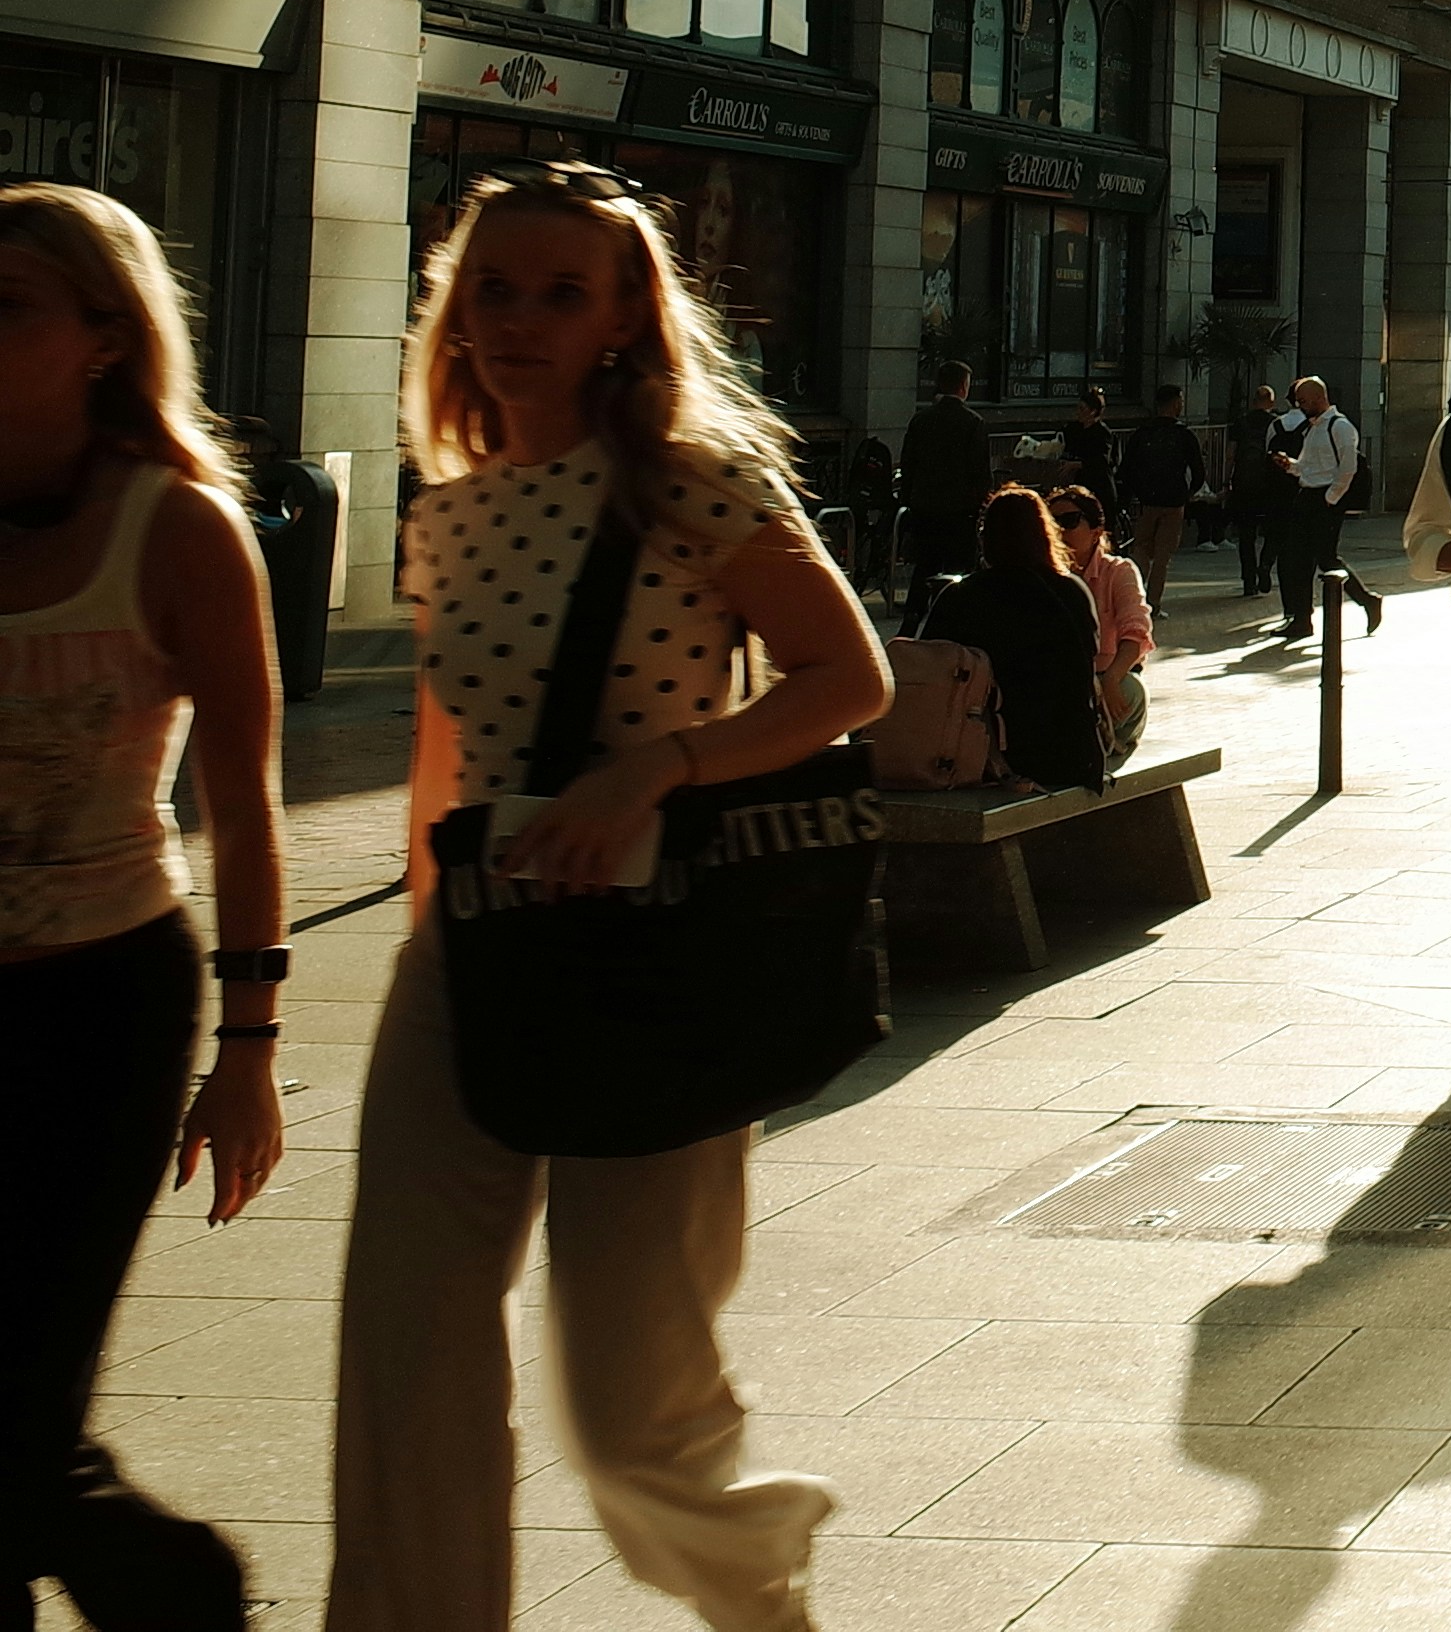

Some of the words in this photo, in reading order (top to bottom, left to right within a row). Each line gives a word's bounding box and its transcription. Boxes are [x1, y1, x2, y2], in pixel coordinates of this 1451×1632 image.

[501, 55, 523, 99] BAG
[518, 56, 547, 101] CITY
[934, 147, 968, 170] GIFTS
[1097, 172, 1146, 195] SOUVENIRS
